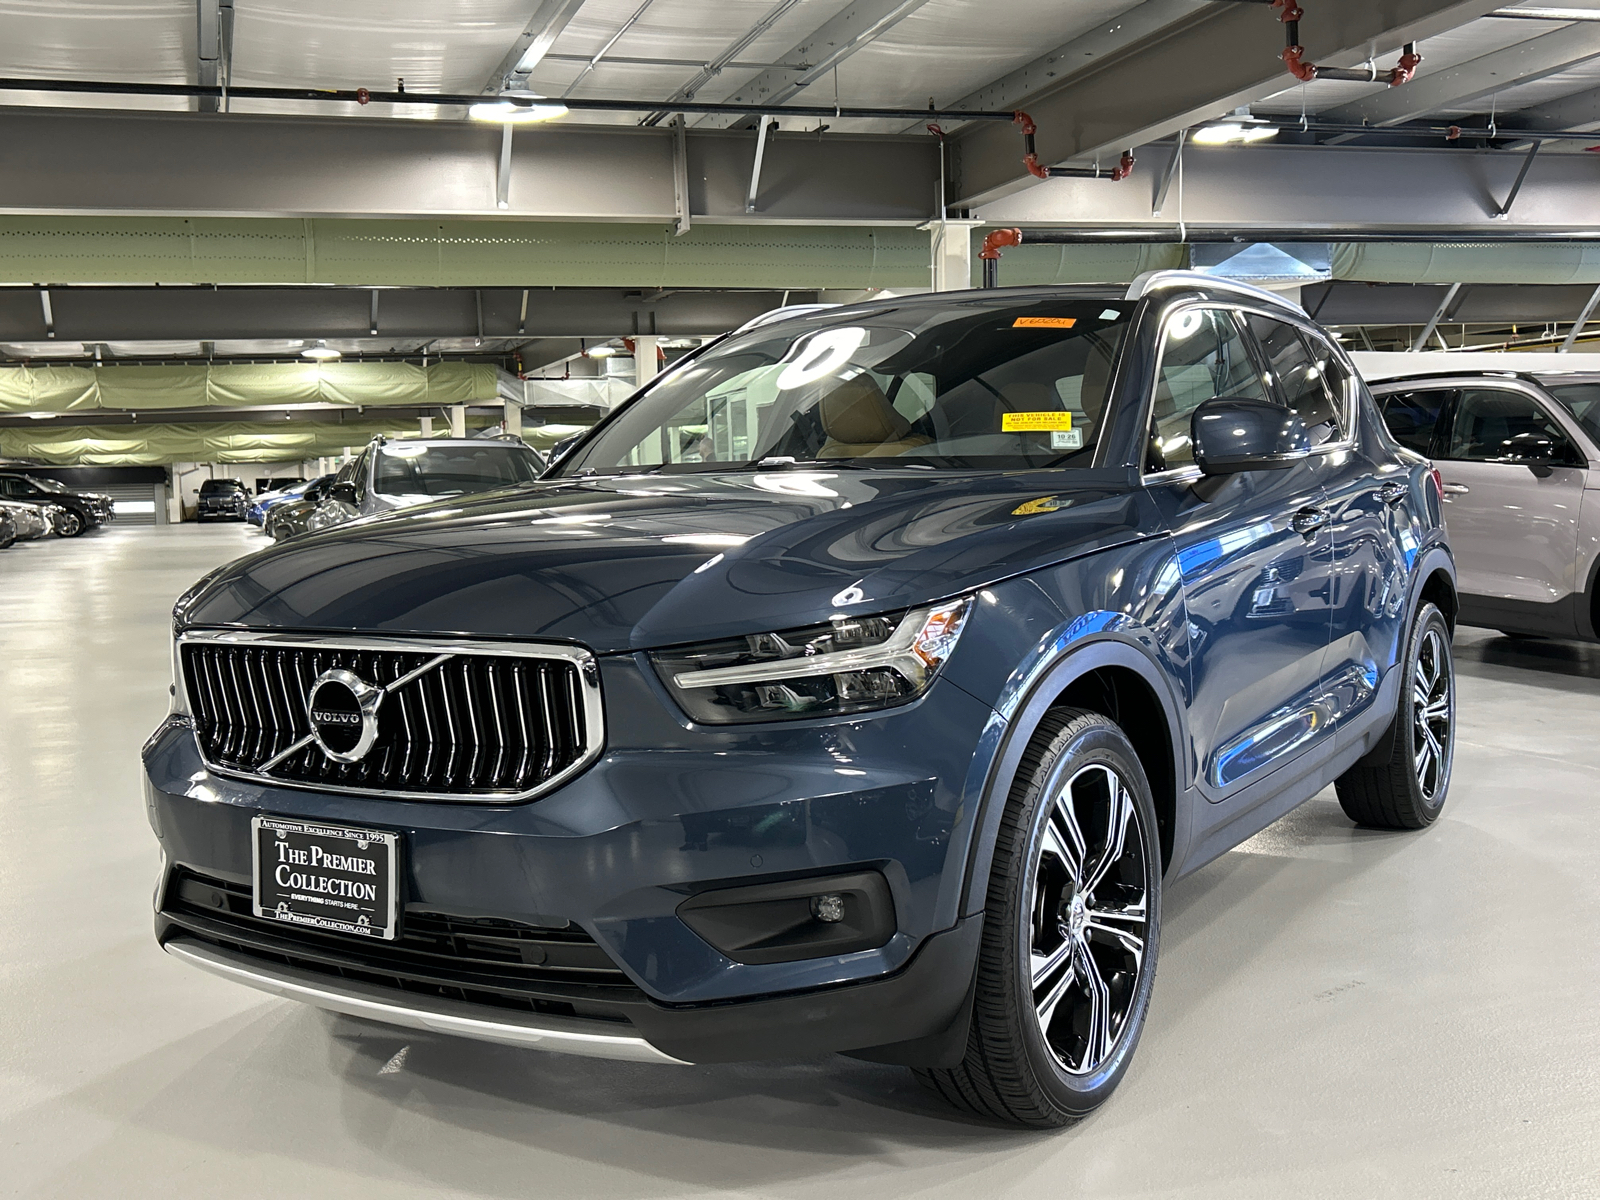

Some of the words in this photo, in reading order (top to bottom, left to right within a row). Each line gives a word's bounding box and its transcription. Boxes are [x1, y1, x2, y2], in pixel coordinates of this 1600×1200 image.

[312, 711, 360, 723] VOLVO
[261, 820, 303, 832] AUTOMOTIVE
[303, 823, 344, 837] EXCELLENCE
[344, 830, 364, 840] SINCE
[365, 833, 385, 842] 1995
[274, 840, 309, 865] THE
[310, 845, 377, 876] PREMIER
[275, 864, 377, 901] COLLECTION
[290, 893, 324, 904] EVERYTHING
[324, 898, 343, 908] STARTS
